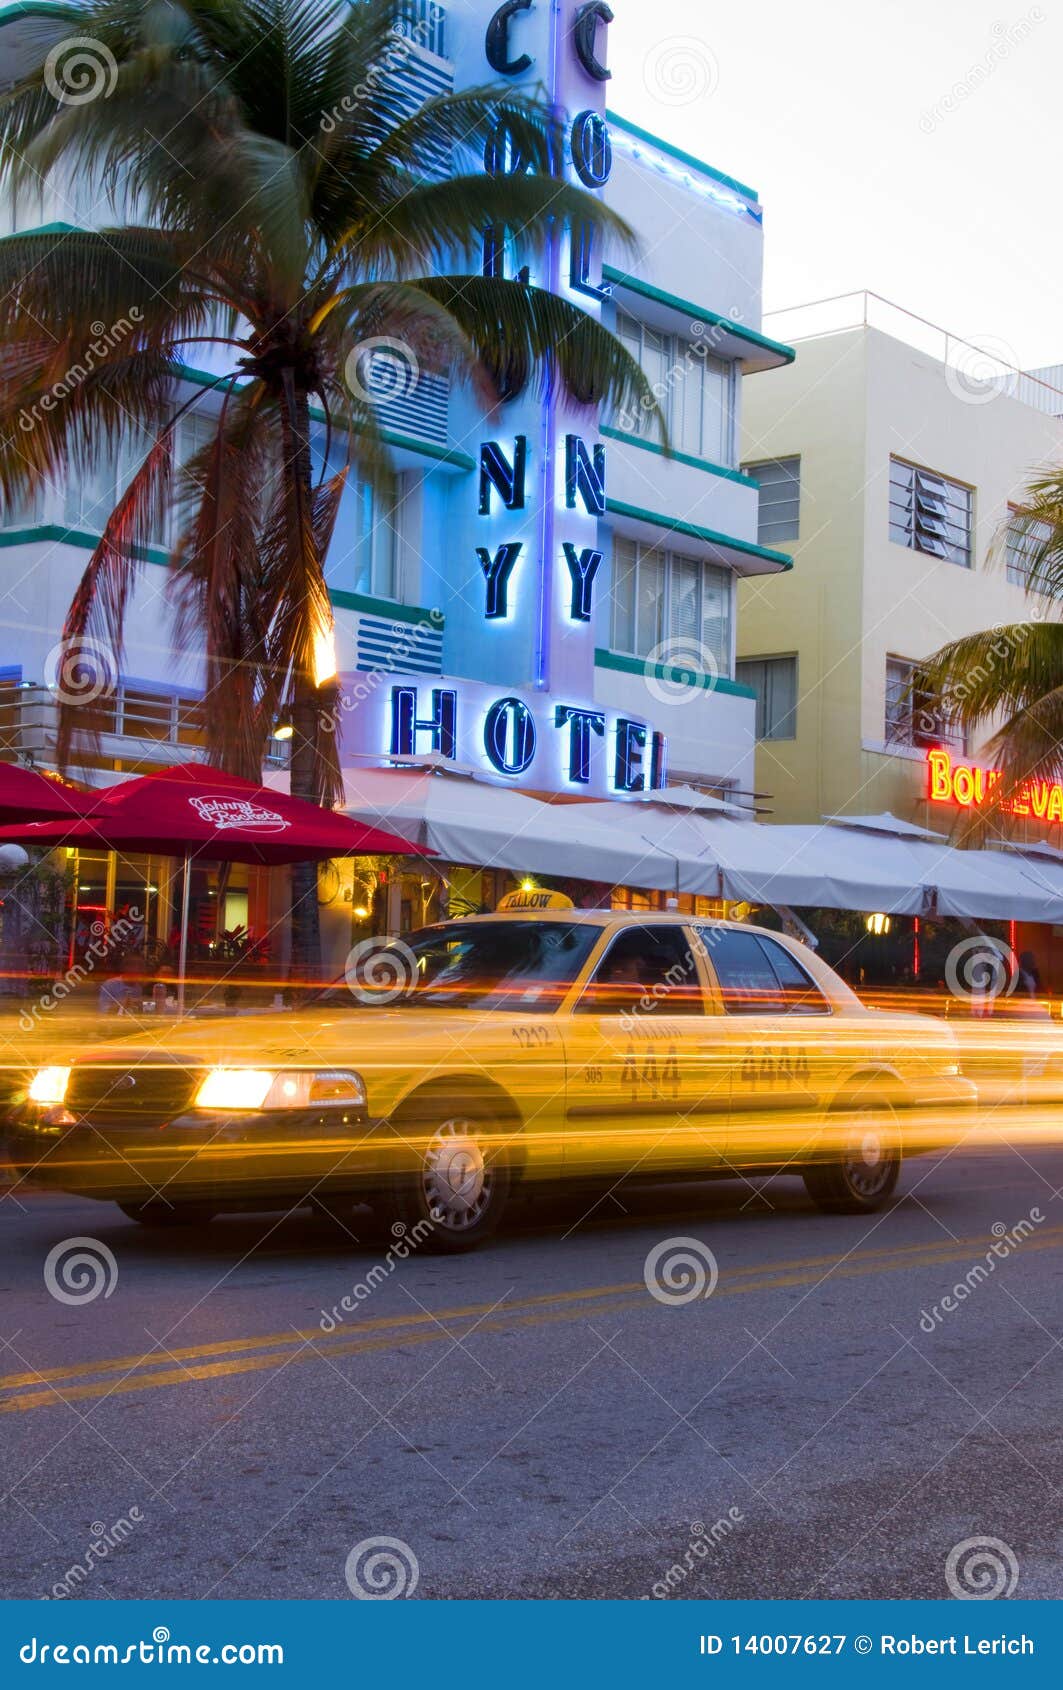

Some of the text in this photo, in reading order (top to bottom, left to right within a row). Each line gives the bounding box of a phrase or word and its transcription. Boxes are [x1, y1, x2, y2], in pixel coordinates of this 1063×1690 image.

[476, 0, 534, 620] CLNY
[562, 0, 615, 622] COLNY
[188, 797, 262, 822] Johnny
[210, 810, 282, 823] Rockets
[512, 1025, 553, 1048] 1212
[584, 1045, 809, 1100] 305 444 4444
